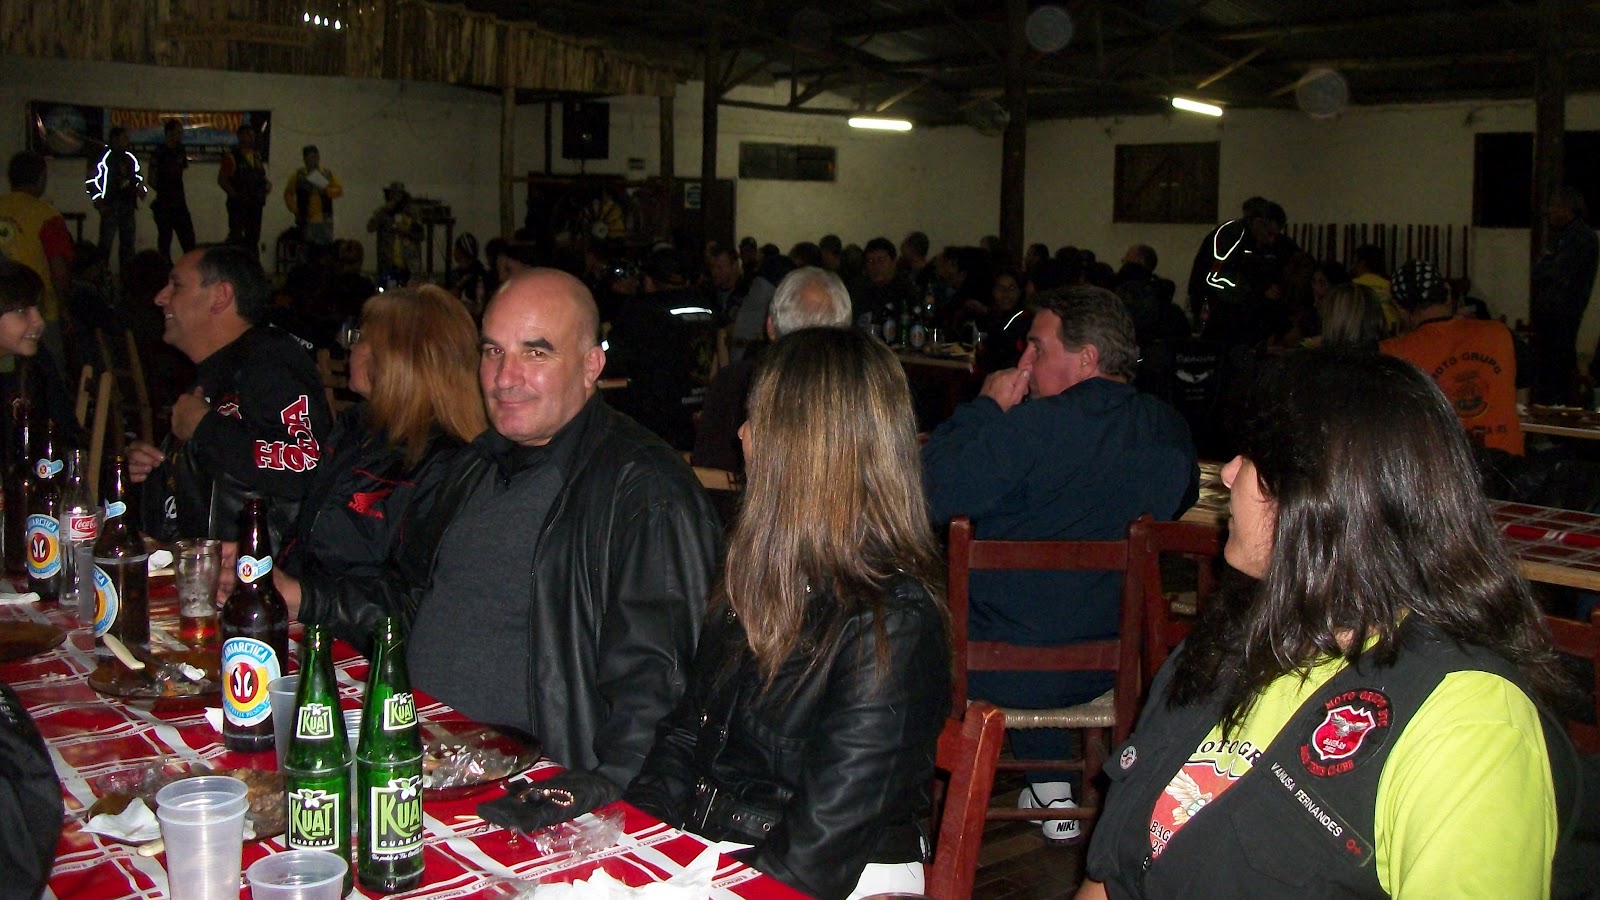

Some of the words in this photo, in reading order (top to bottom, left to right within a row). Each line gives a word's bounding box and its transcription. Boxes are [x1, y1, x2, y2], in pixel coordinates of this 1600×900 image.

[1431, 356, 1457, 378] OTO
[224, 641, 268, 661] ANTARCTICA
[1325, 691, 1356, 710] MOTO
[302, 710, 329, 735] KUAT
[1270, 762, 1296, 791] VANUSA
[1294, 789, 1343, 837] FERNANDES
[292, 799, 334, 840] KUAT
[1056, 821, 1075, 832] NIKE
[1149, 821, 1172, 842] BAG
